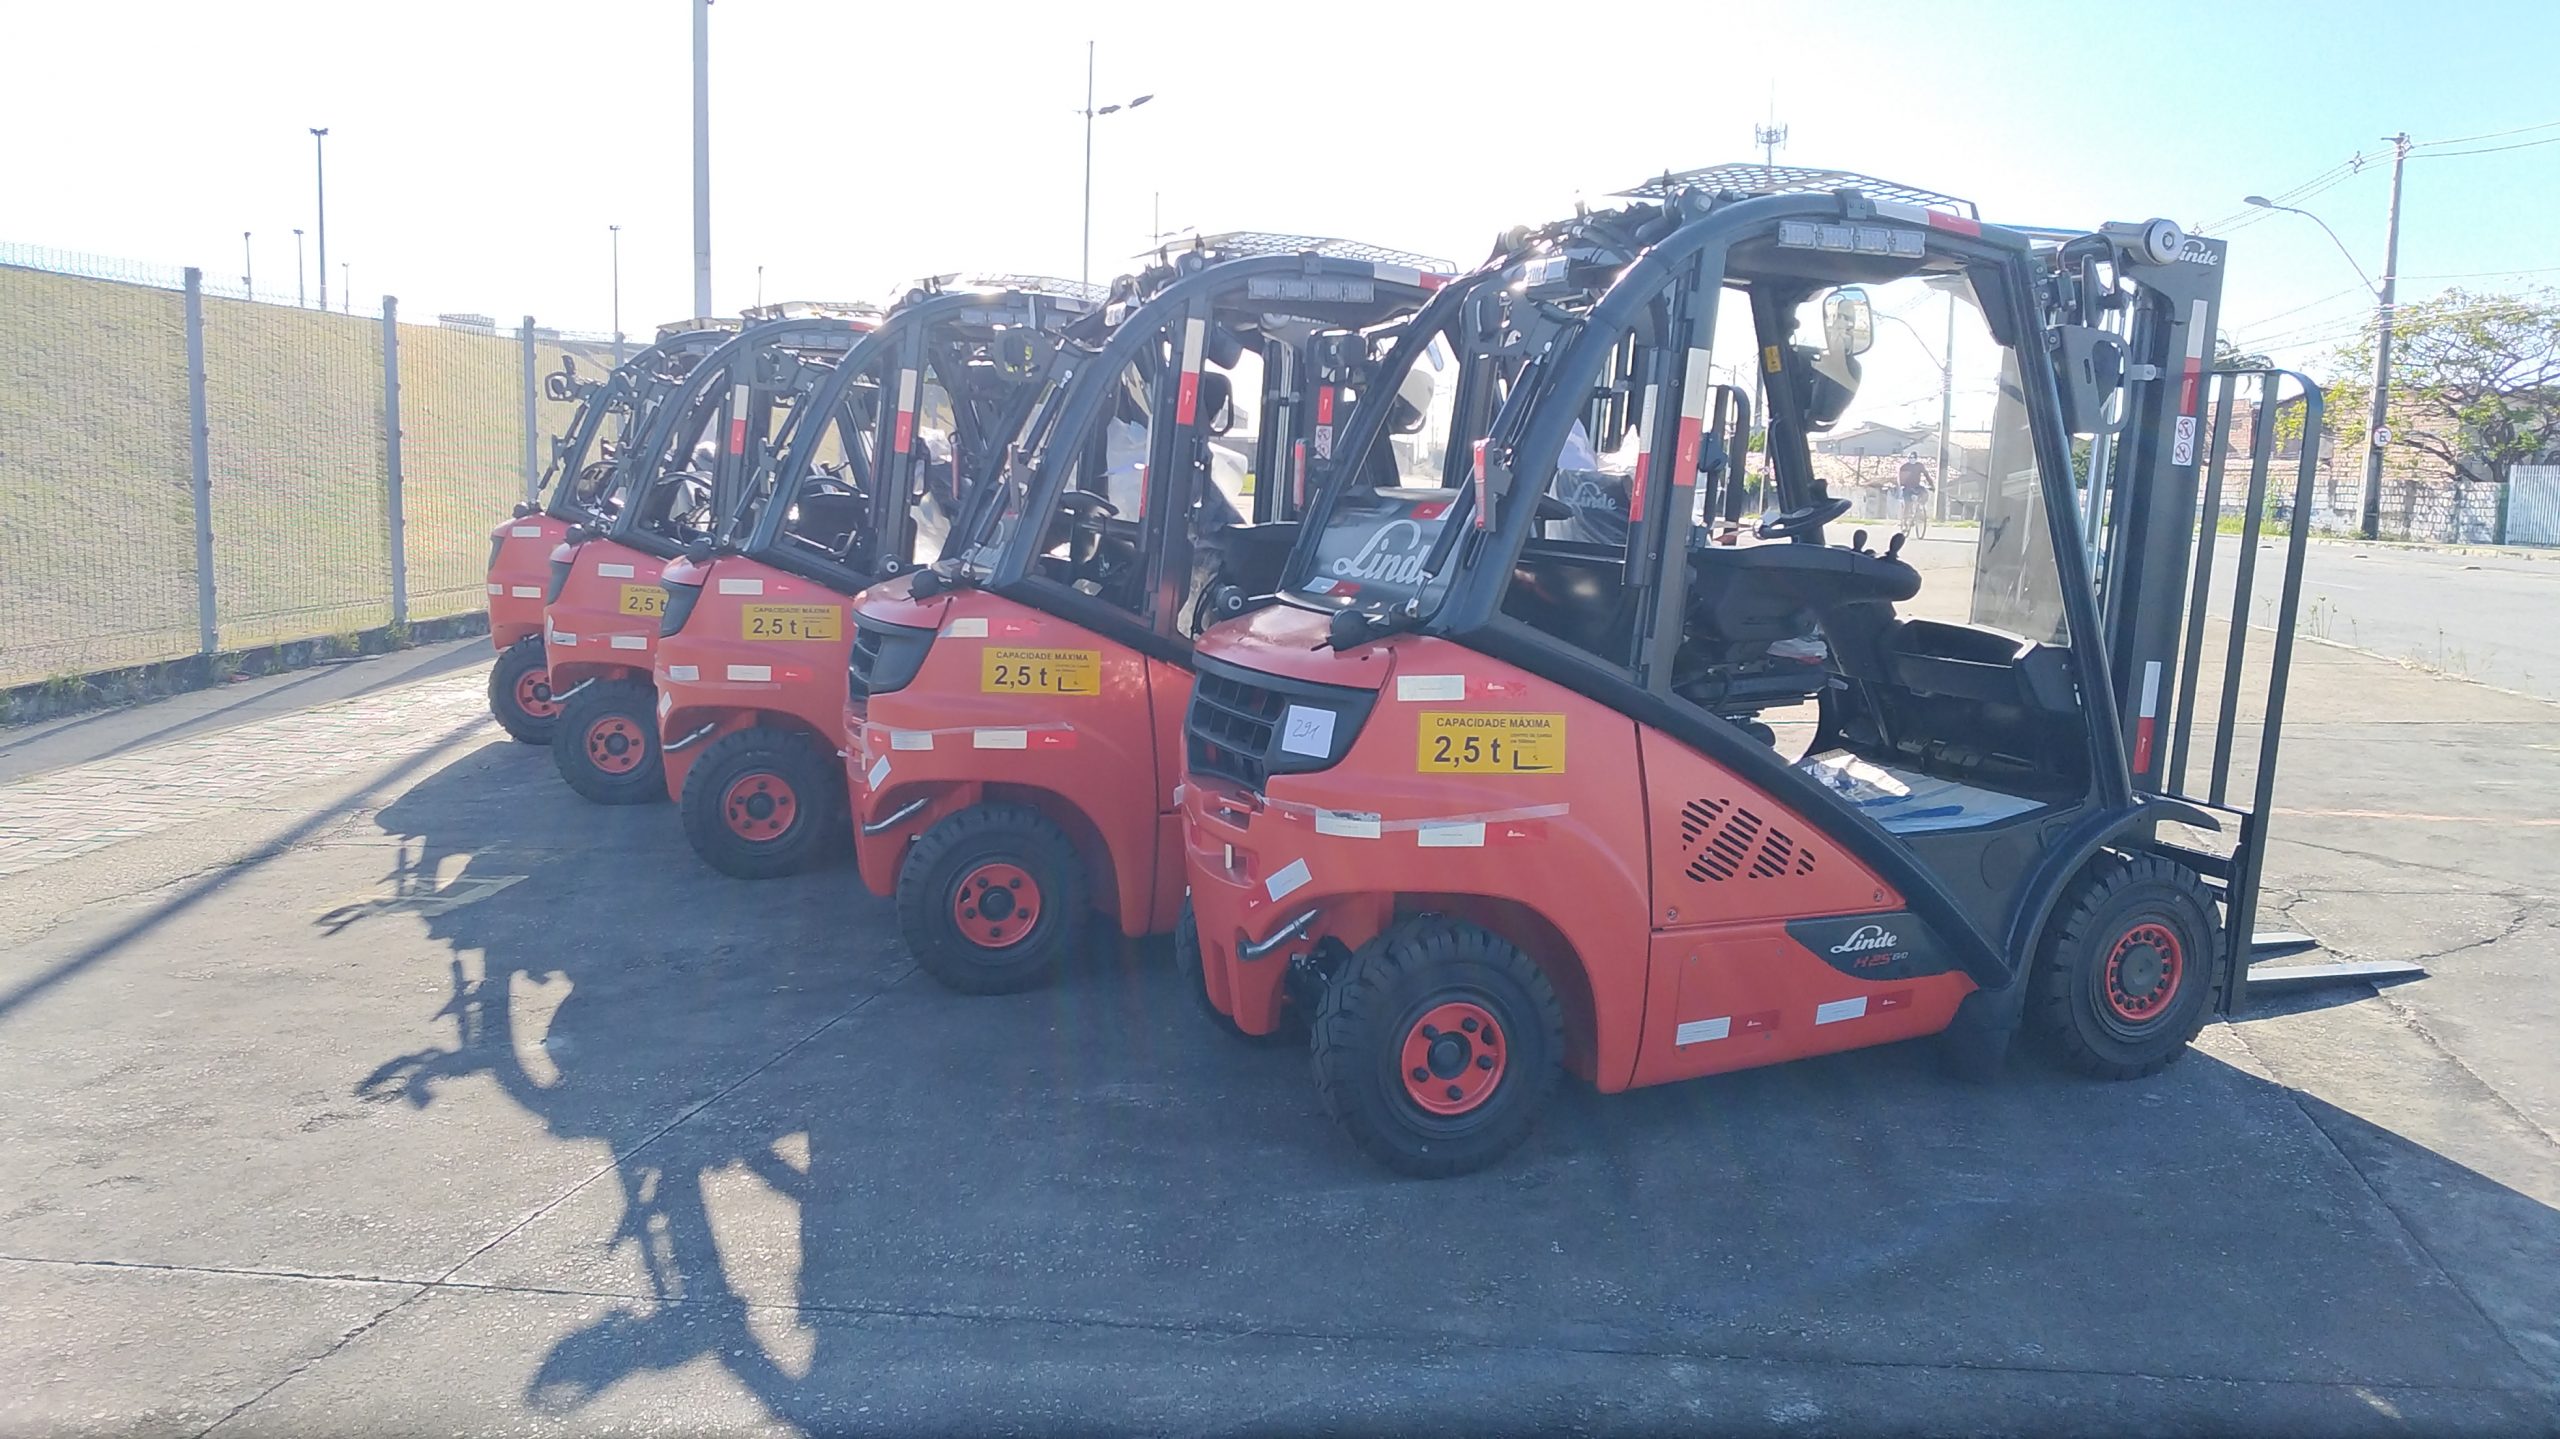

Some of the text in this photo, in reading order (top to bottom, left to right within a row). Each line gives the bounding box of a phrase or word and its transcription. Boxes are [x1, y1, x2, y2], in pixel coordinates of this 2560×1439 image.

[629, 596, 666, 613] 2,5 t
[752, 617, 797, 637] 2,5 t
[996, 651, 1089, 662] CAPACIDADE MÁXIMA
[993, 665, 1048, 689] 2,5 t
[1436, 716, 1551, 729] CAPACIDADE MÁXIMA
[1433, 735, 1501, 768] 2,5 t
[1830, 925, 1898, 954] Linde
